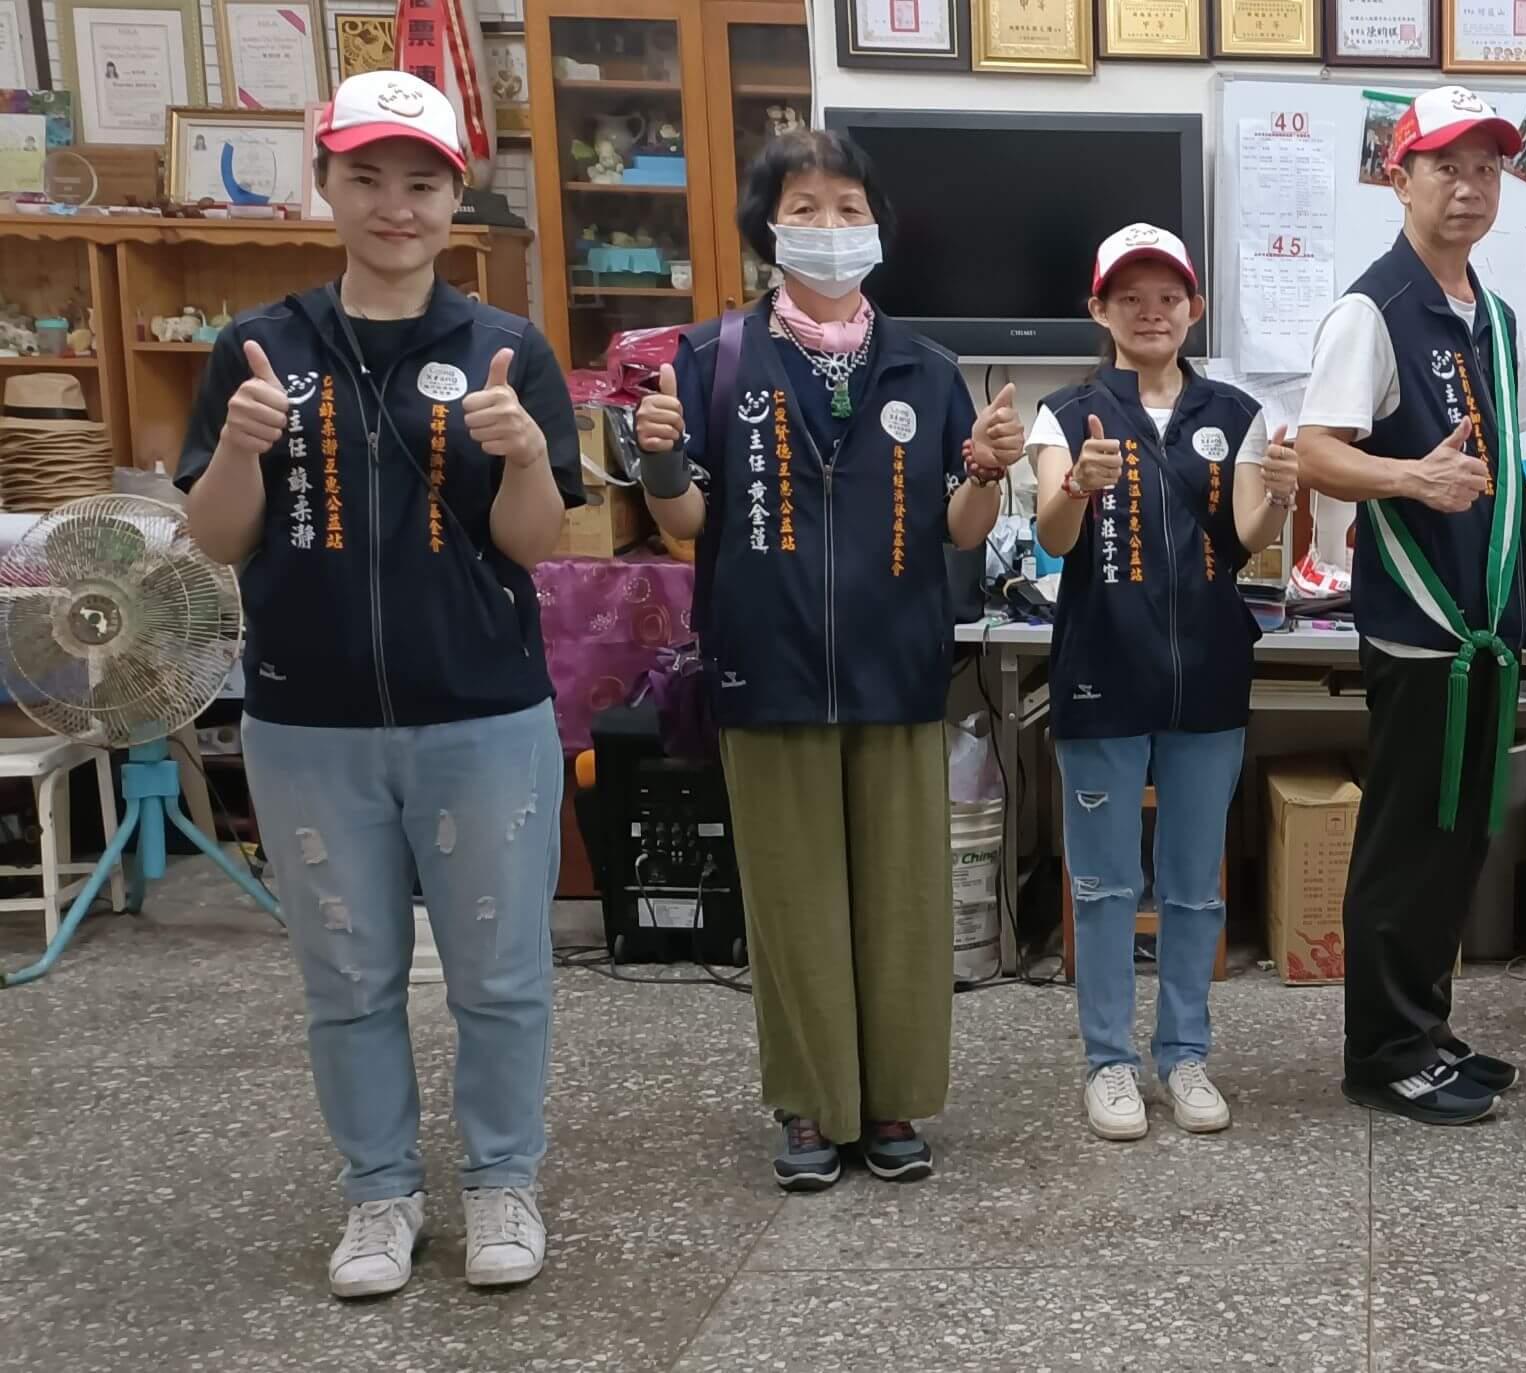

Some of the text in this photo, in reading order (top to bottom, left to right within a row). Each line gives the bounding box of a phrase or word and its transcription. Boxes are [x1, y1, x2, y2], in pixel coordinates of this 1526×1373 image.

[1274, 112, 1304, 132] 40
[1272, 236, 1302, 256] 45
[1446, 384, 1462, 424] 主任
[288, 410, 308, 458] 主任
[749, 429, 766, 472] 主任
